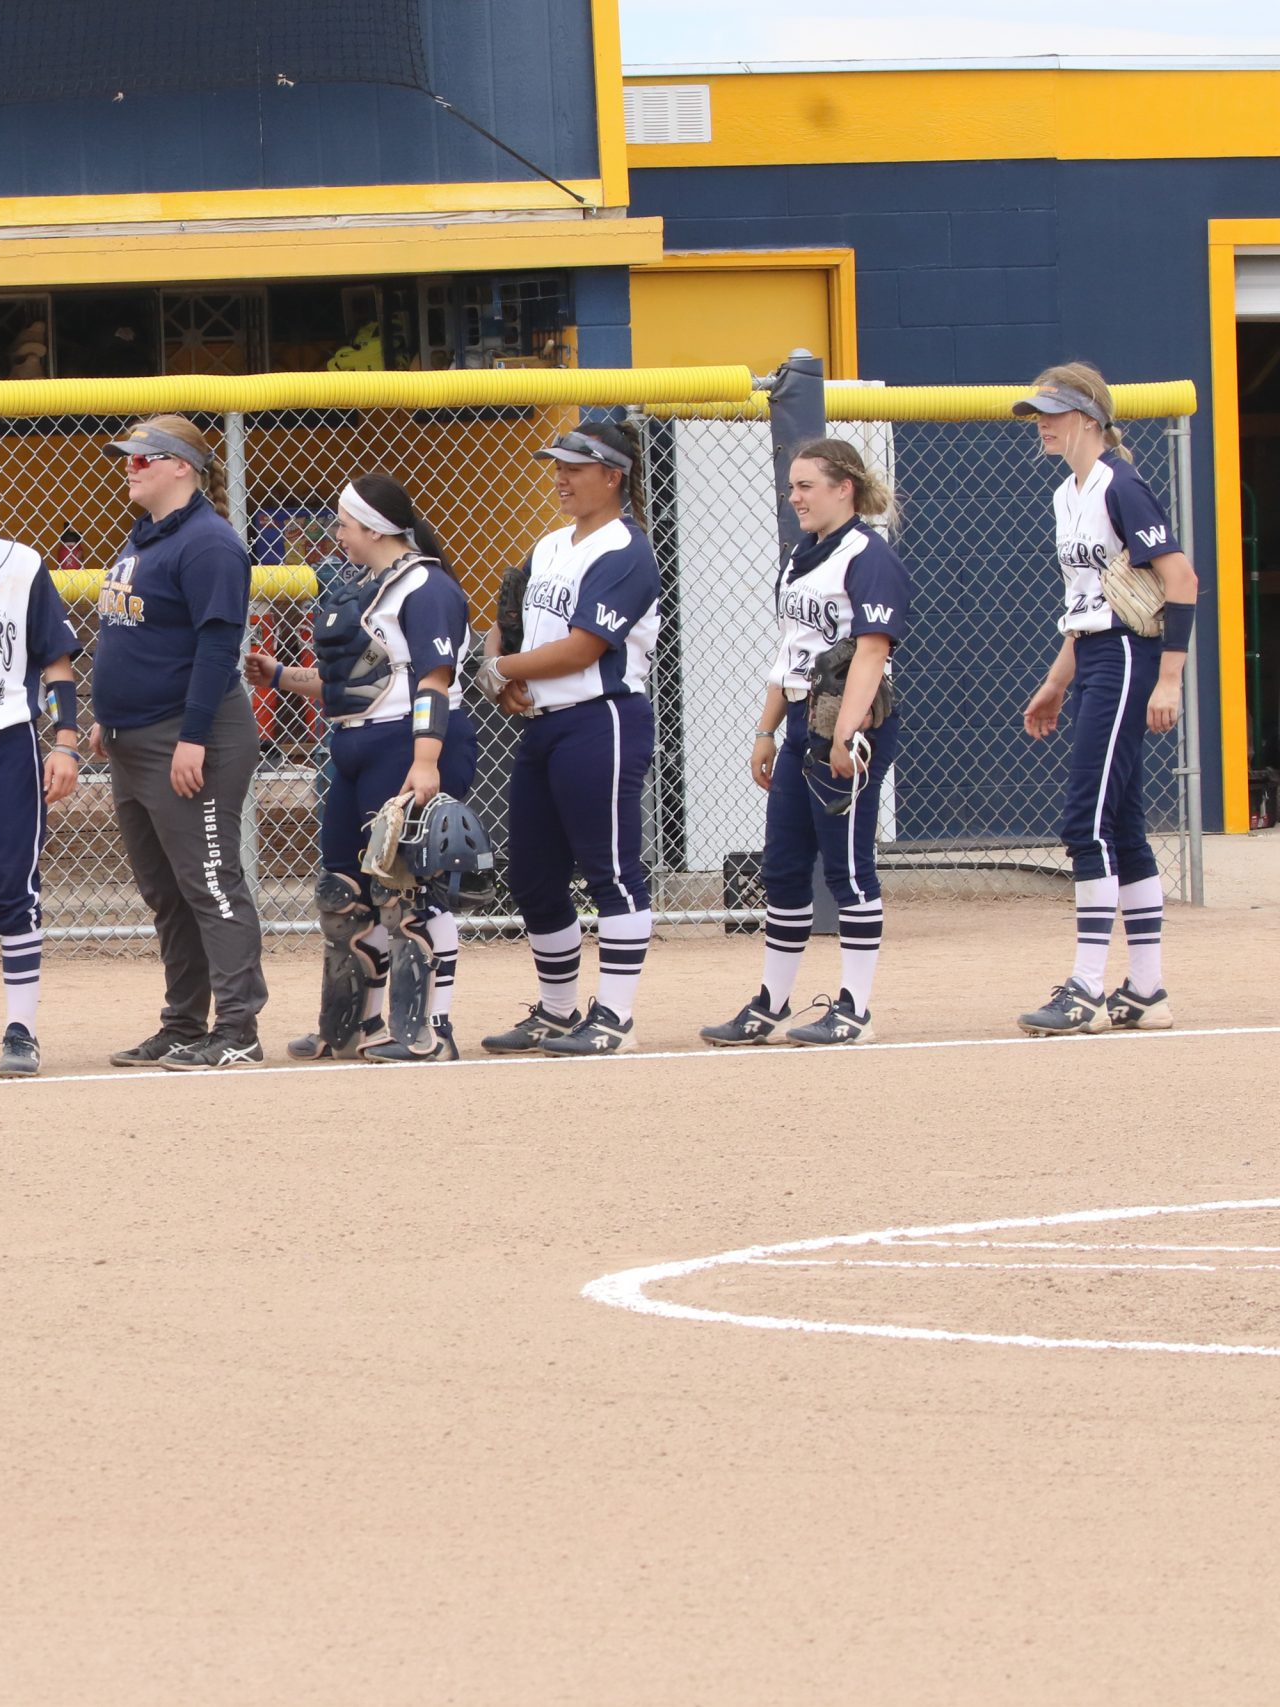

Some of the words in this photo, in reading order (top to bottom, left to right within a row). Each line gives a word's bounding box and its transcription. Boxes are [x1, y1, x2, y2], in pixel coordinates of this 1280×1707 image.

[1135, 524, 1167, 548] W
[596, 602, 628, 632] W
[862, 603, 894, 625] W
[203, 798, 223, 867] SOFTBALL
